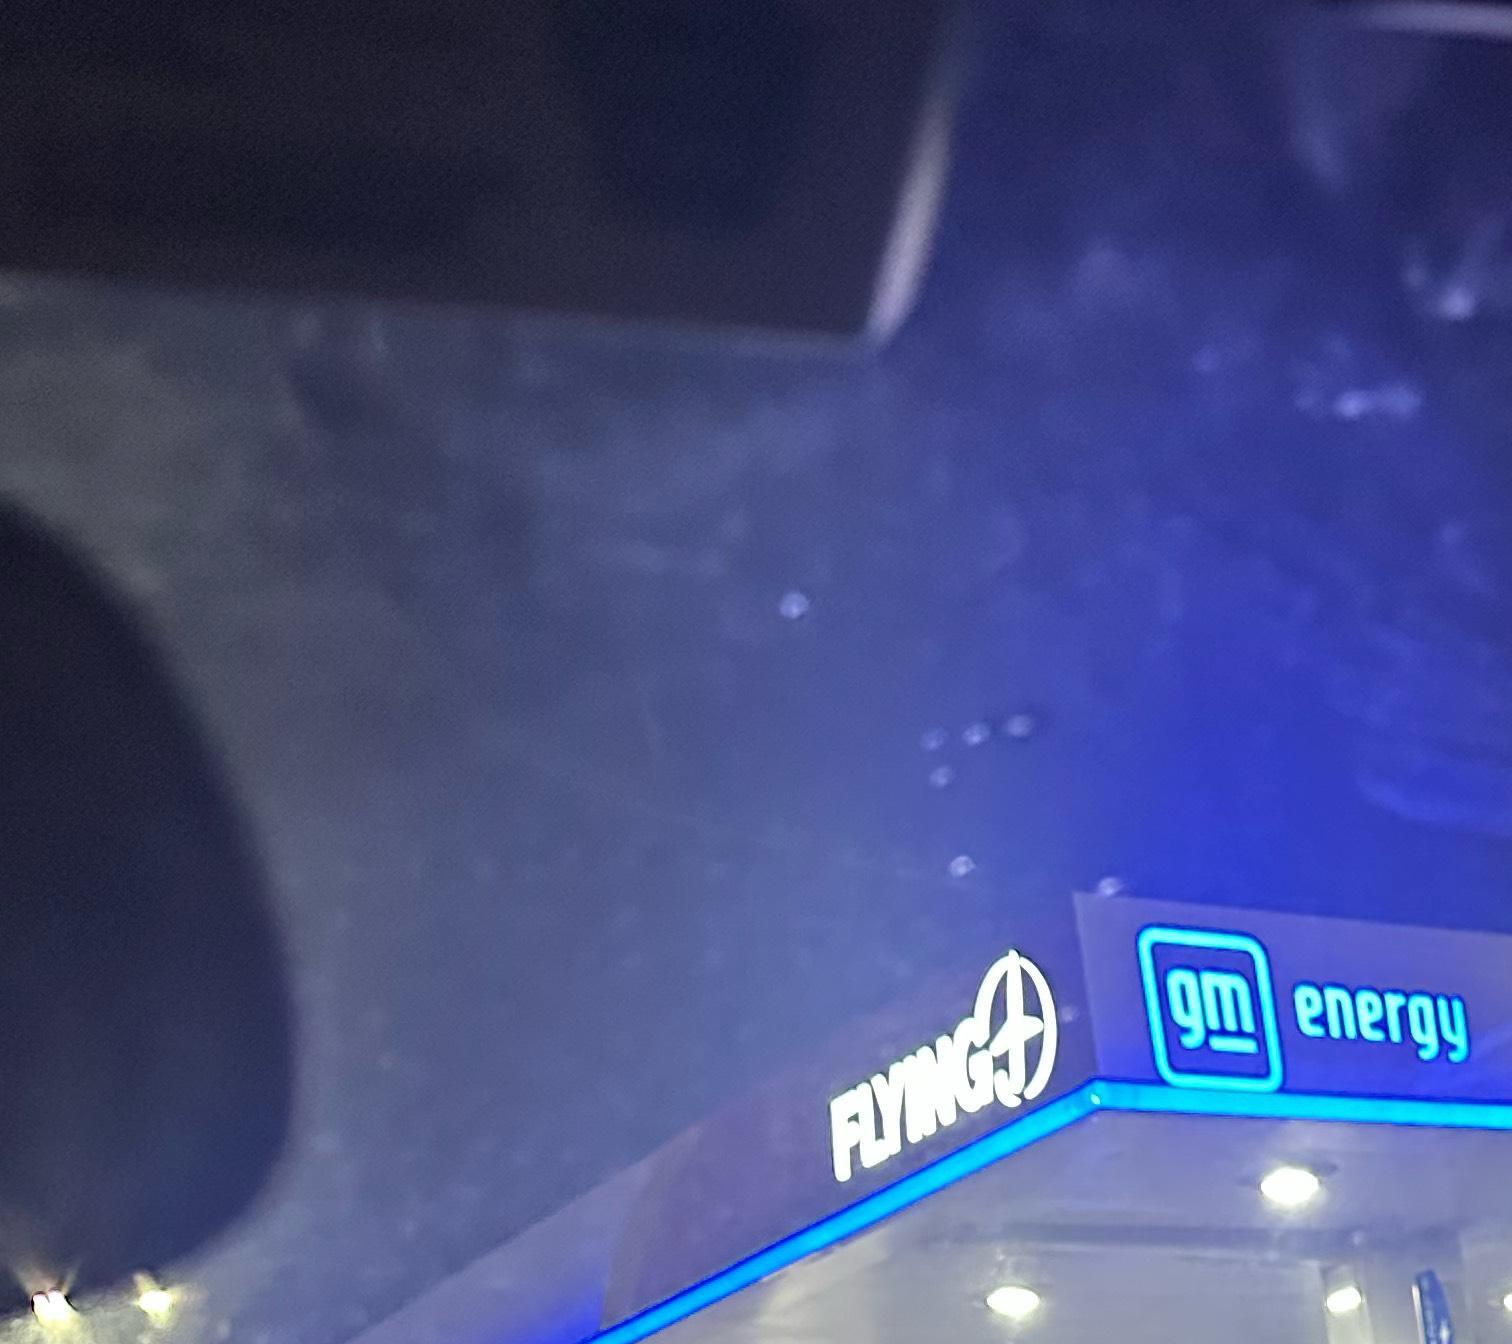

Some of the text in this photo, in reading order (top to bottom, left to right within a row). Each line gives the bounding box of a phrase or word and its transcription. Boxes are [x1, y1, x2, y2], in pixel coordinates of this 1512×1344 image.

[1165, 967, 1470, 1064] gm energy
[829, 1016, 994, 1183] FLYING
